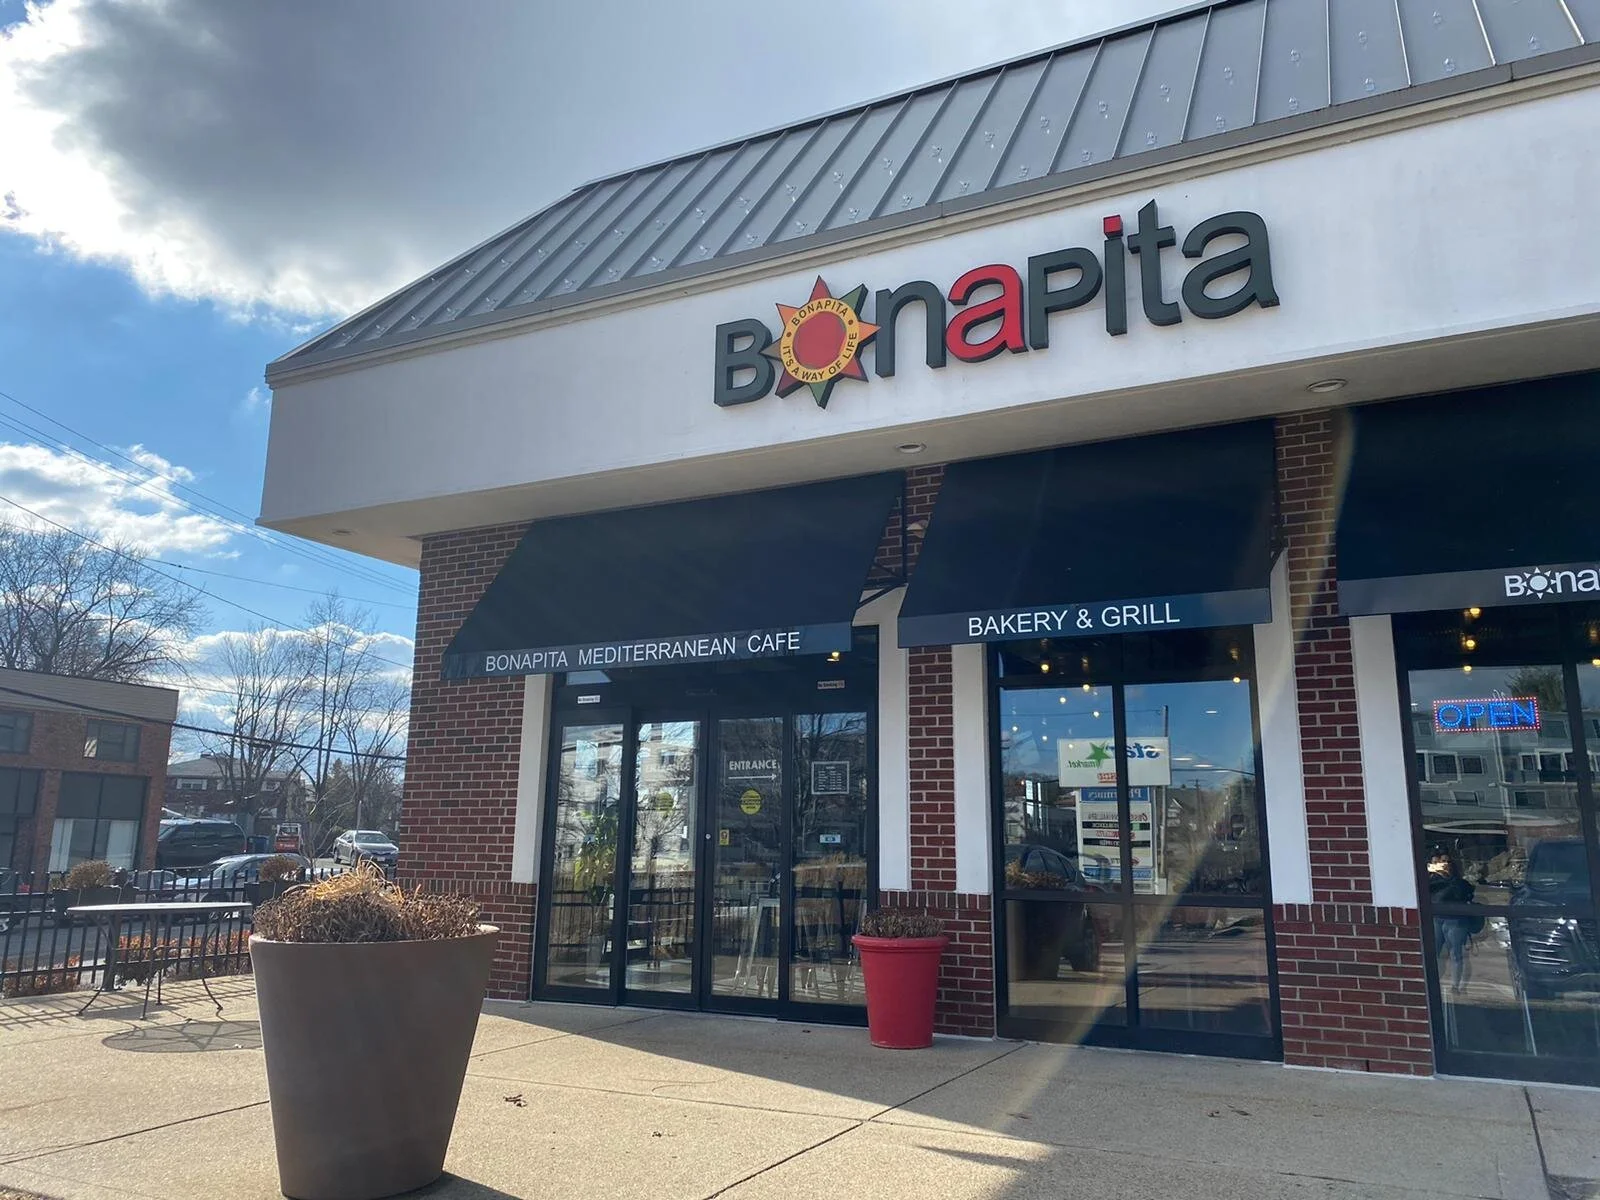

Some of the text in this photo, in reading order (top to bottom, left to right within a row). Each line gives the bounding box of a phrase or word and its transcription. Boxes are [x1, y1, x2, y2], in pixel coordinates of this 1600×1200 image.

[791, 299, 849, 326] BONAPITA
[782, 332, 858, 381] IT'S A WAY OF LIFE
[1504, 567, 1600, 599] Bona
[968, 602, 1180, 637] BAKERY & GRILL
[485, 632, 800, 672] BONAPITA MEDITERRANEAN CAFE
[1437, 701, 1536, 727] OPEN
[728, 759, 777, 771] ENTRANCE
